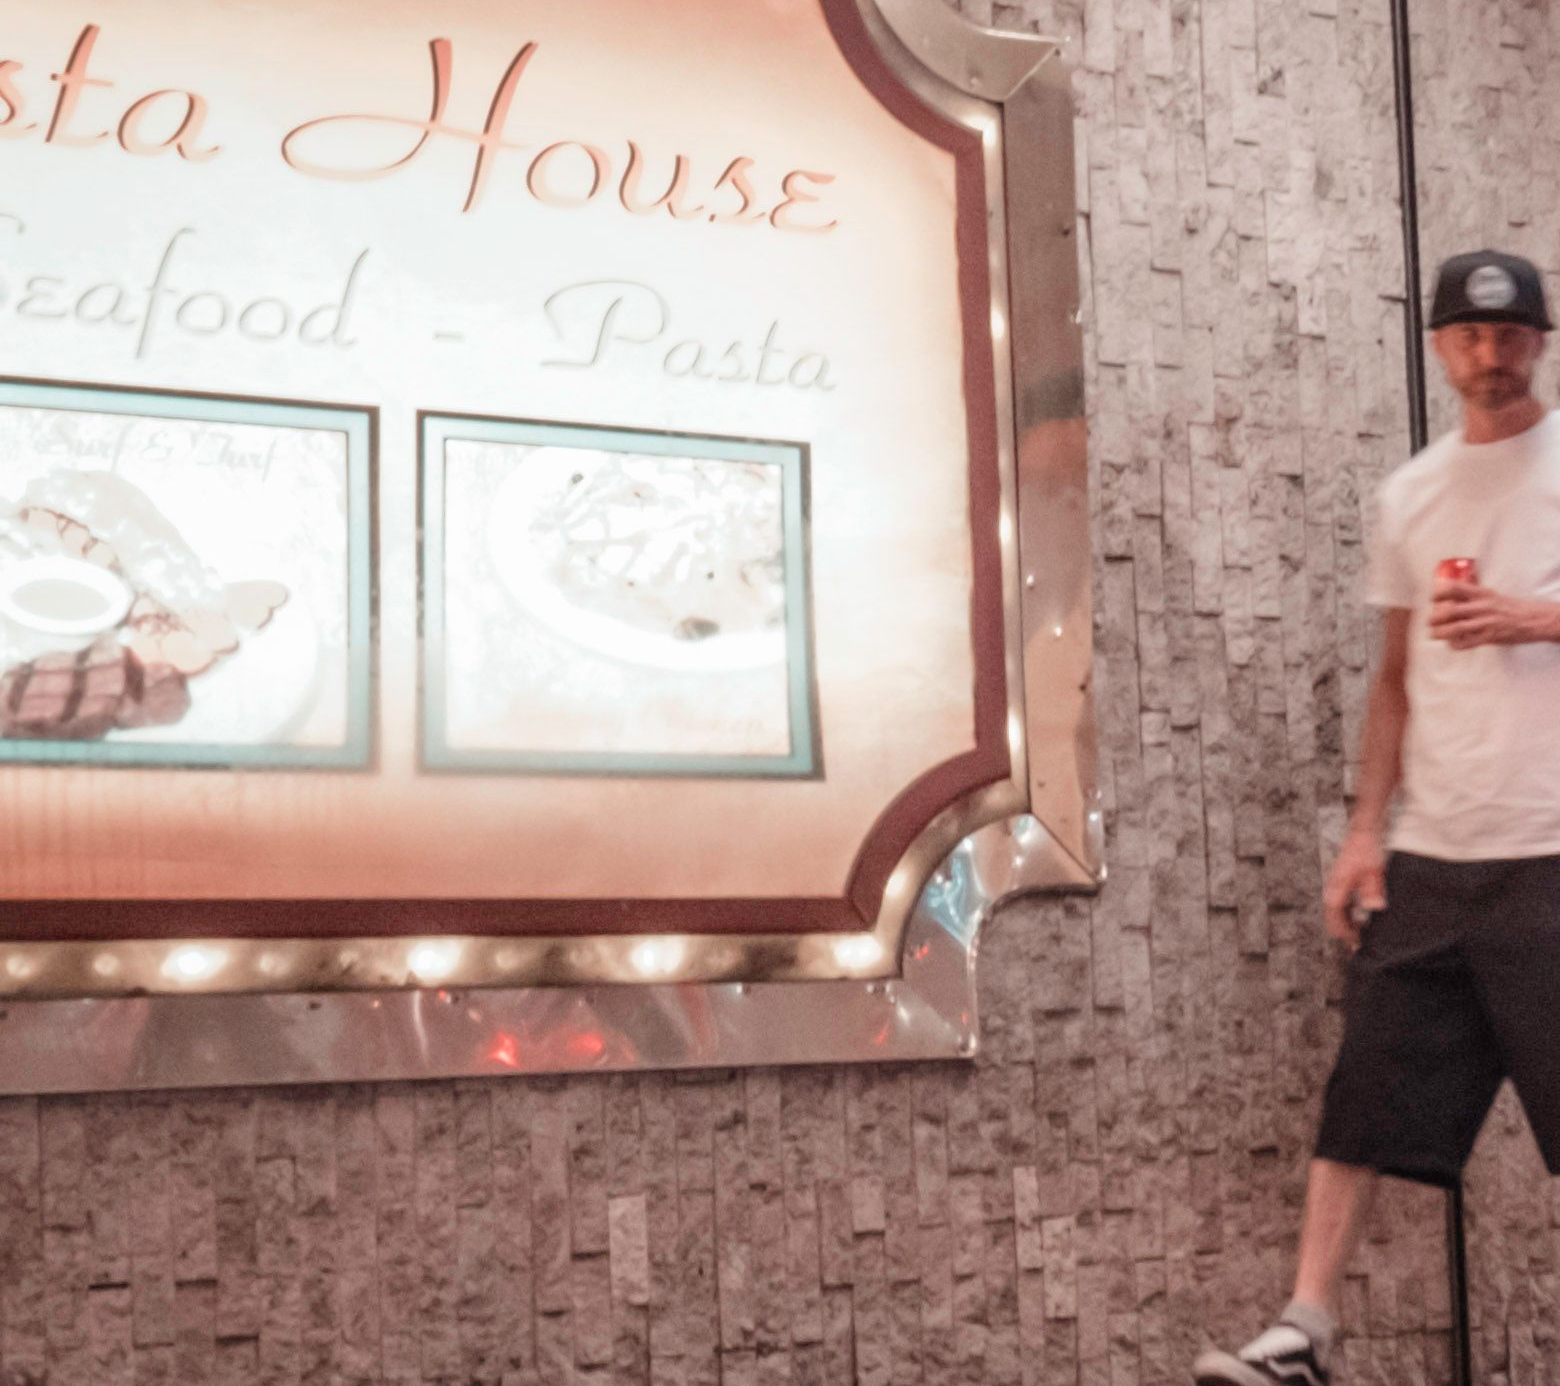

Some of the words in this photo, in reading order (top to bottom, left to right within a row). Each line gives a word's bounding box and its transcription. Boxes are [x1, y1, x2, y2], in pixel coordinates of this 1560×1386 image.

[281, 35, 841, 232] House
[0, 215, 369, 359] eafood
[542, 277, 839, 393] Pasta
